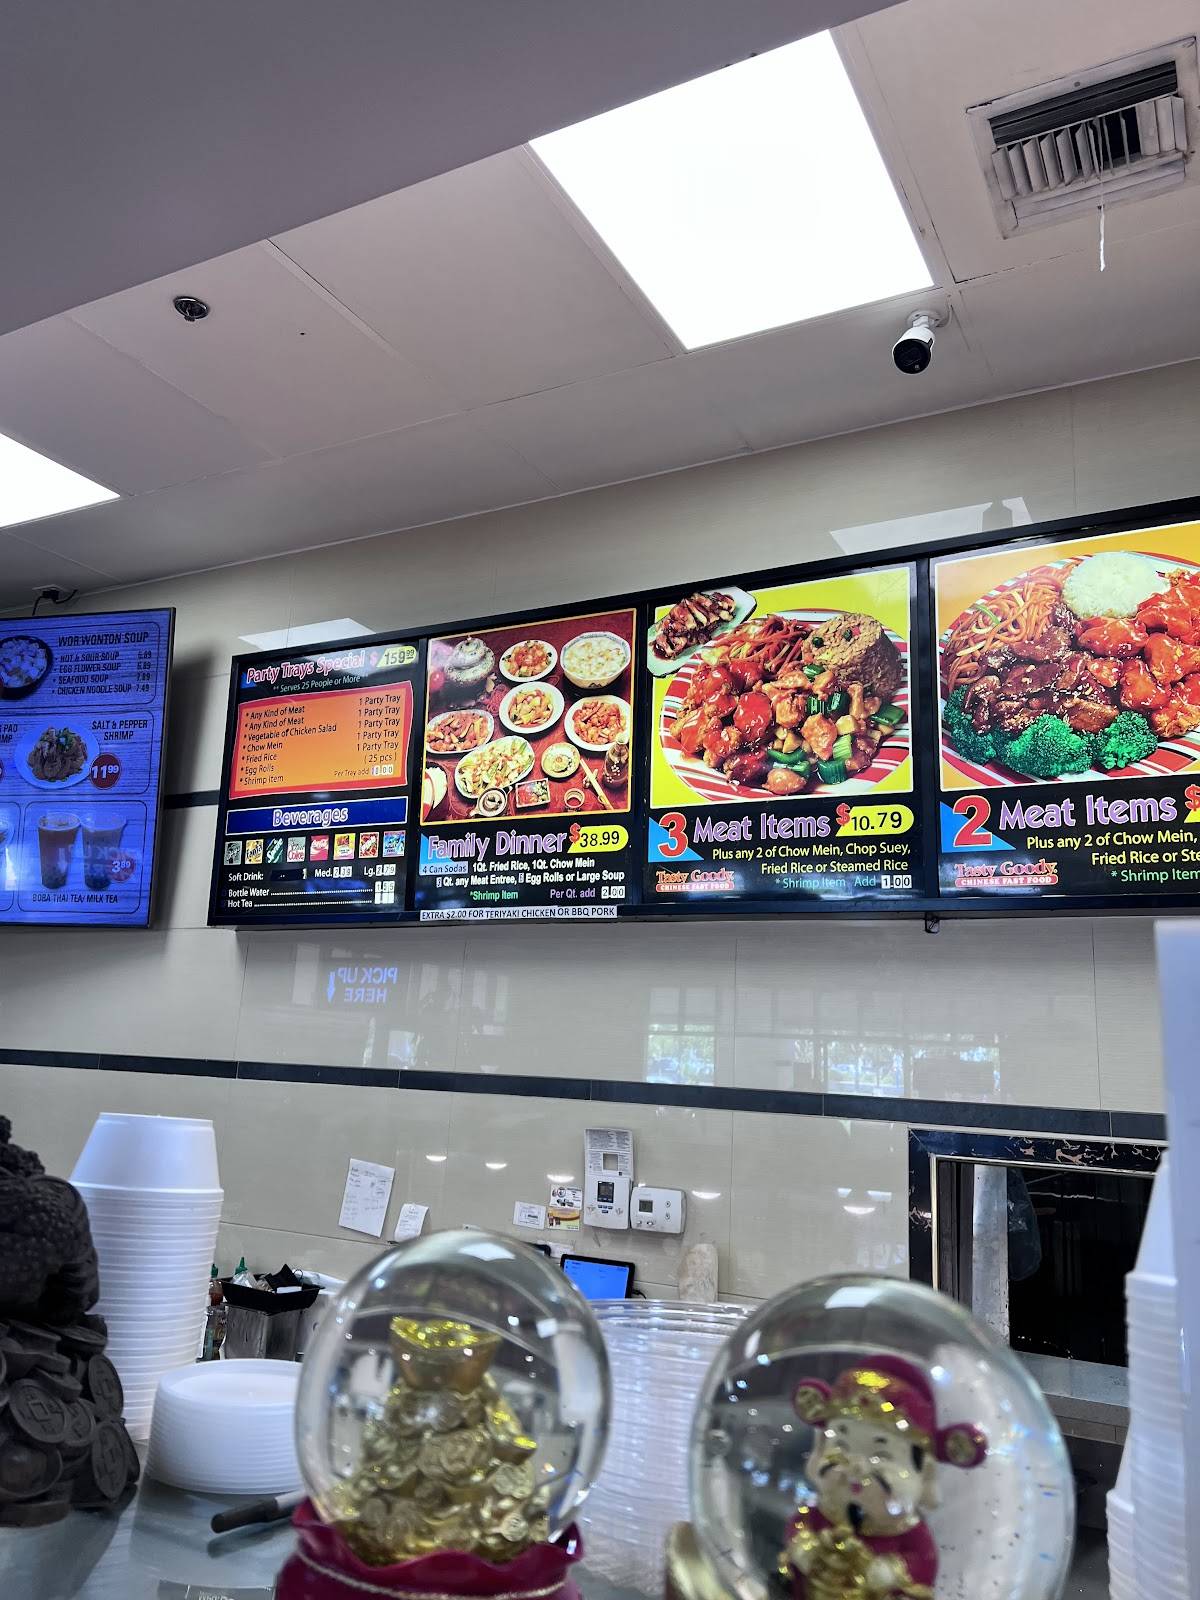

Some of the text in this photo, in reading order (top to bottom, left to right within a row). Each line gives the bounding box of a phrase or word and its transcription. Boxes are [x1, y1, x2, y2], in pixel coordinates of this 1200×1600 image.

[59, 632, 149, 647] WOR WONTON SOUP
[100, 652, 120, 660] SOUP
[60, 663, 121, 673] EGG FLOWER SOUP
[246, 650, 366, 684] Party Trays Special
[59, 674, 109, 684] SEAFOOD SOUP
[280, 684, 300, 692] Serves
[302, 682, 309, 690] 25
[311, 678, 333, 689] People
[343, 676, 360, 684] More
[58, 684, 132, 695] CHICKEN NOODLE SOUP
[365, 695, 401, 705] Party Tray
[250, 706, 305, 720] Any Kind of Meat
[364, 706, 400, 717] Party Tray
[92, 720, 148, 730] SALT & PEPPER
[249, 717, 304, 731] Any Kind of Meat
[364, 718, 400, 728] Party Tray
[104, 731, 134, 740] SHRIMP
[248, 724, 337, 742] Vegetable Chicken Salad
[363, 729, 399, 740] Party Tray
[247, 742, 283, 752] Chow Mein
[363, 741, 399, 752] Party Tray
[247, 753, 277, 764] Fried Rice
[246, 765, 274, 776] Egg Rolls
[244, 775, 284, 786] Shrimp Item
[273, 808, 348, 827] Beverages
[953, 795, 1178, 848] 2 Meat Items
[658, 812, 689, 858] 3
[693, 816, 752, 843] Meat
[761, 813, 831, 840] Items
[1027, 830, 1197, 850] Plus any 2 of Chow Mein,
[428, 832, 490, 861] Family
[496, 829, 567, 855] Dinner
[713, 842, 910, 861] Plus any 2 of Chow Mein, Chop Suey,
[473, 857, 595, 872] 1Qt. Fried Rice, 1Qt. Chow Mein
[1092, 851, 1126, 866] Fried
[1130, 851, 1159, 864] Rice
[1162, 852, 1178, 864] or
[423, 866, 427, 874] 4
[445, 864, 467, 873] Sodas
[762, 859, 908, 875] Fried Rice or Steamed Rice
[954, 863, 997, 878] Tasty
[228, 873, 242, 882] Soft
[244, 872, 264, 880] Drink:
[315, 868, 332, 878] Med.
[364, 866, 375, 877] Lg.
[443, 877, 454, 886] Qt.
[456, 877, 469, 888] any
[471, 875, 488, 886] Meat
[490, 874, 517, 885] Entree,
[526, 872, 541, 885] Egg
[543, 872, 564, 882] Rolls
[566, 874, 575, 882] or
[577, 871, 600, 883] Large
[602, 870, 625, 882] Soup
[656, 870, 689, 884] Tasty
[1121, 868, 1200, 883] Shrimp Item
[692, 883, 710, 891] FAST
[783, 875, 912, 889] Shrimp Item Add 1.00
[961, 876, 1052, 886] CHINESE FAST FOOD
[86, 895, 104, 903] MILK
[106, 895, 118, 903] TEA
[229, 888, 270, 898] Bottle Water
[502, 886, 625, 900] Item Per Qt. add 2.00
[228, 899, 253, 908] Hot Tea
[422, 912, 445, 920] EXTRA
[469, 910, 484, 918] FOR
[486, 910, 520, 918] TERIYAKI
[522, 909, 556, 918] CHICKEN
[558, 908, 570, 916] OR
[572, 908, 590, 916] BBQ
[592, 907, 615, 916] PORK
